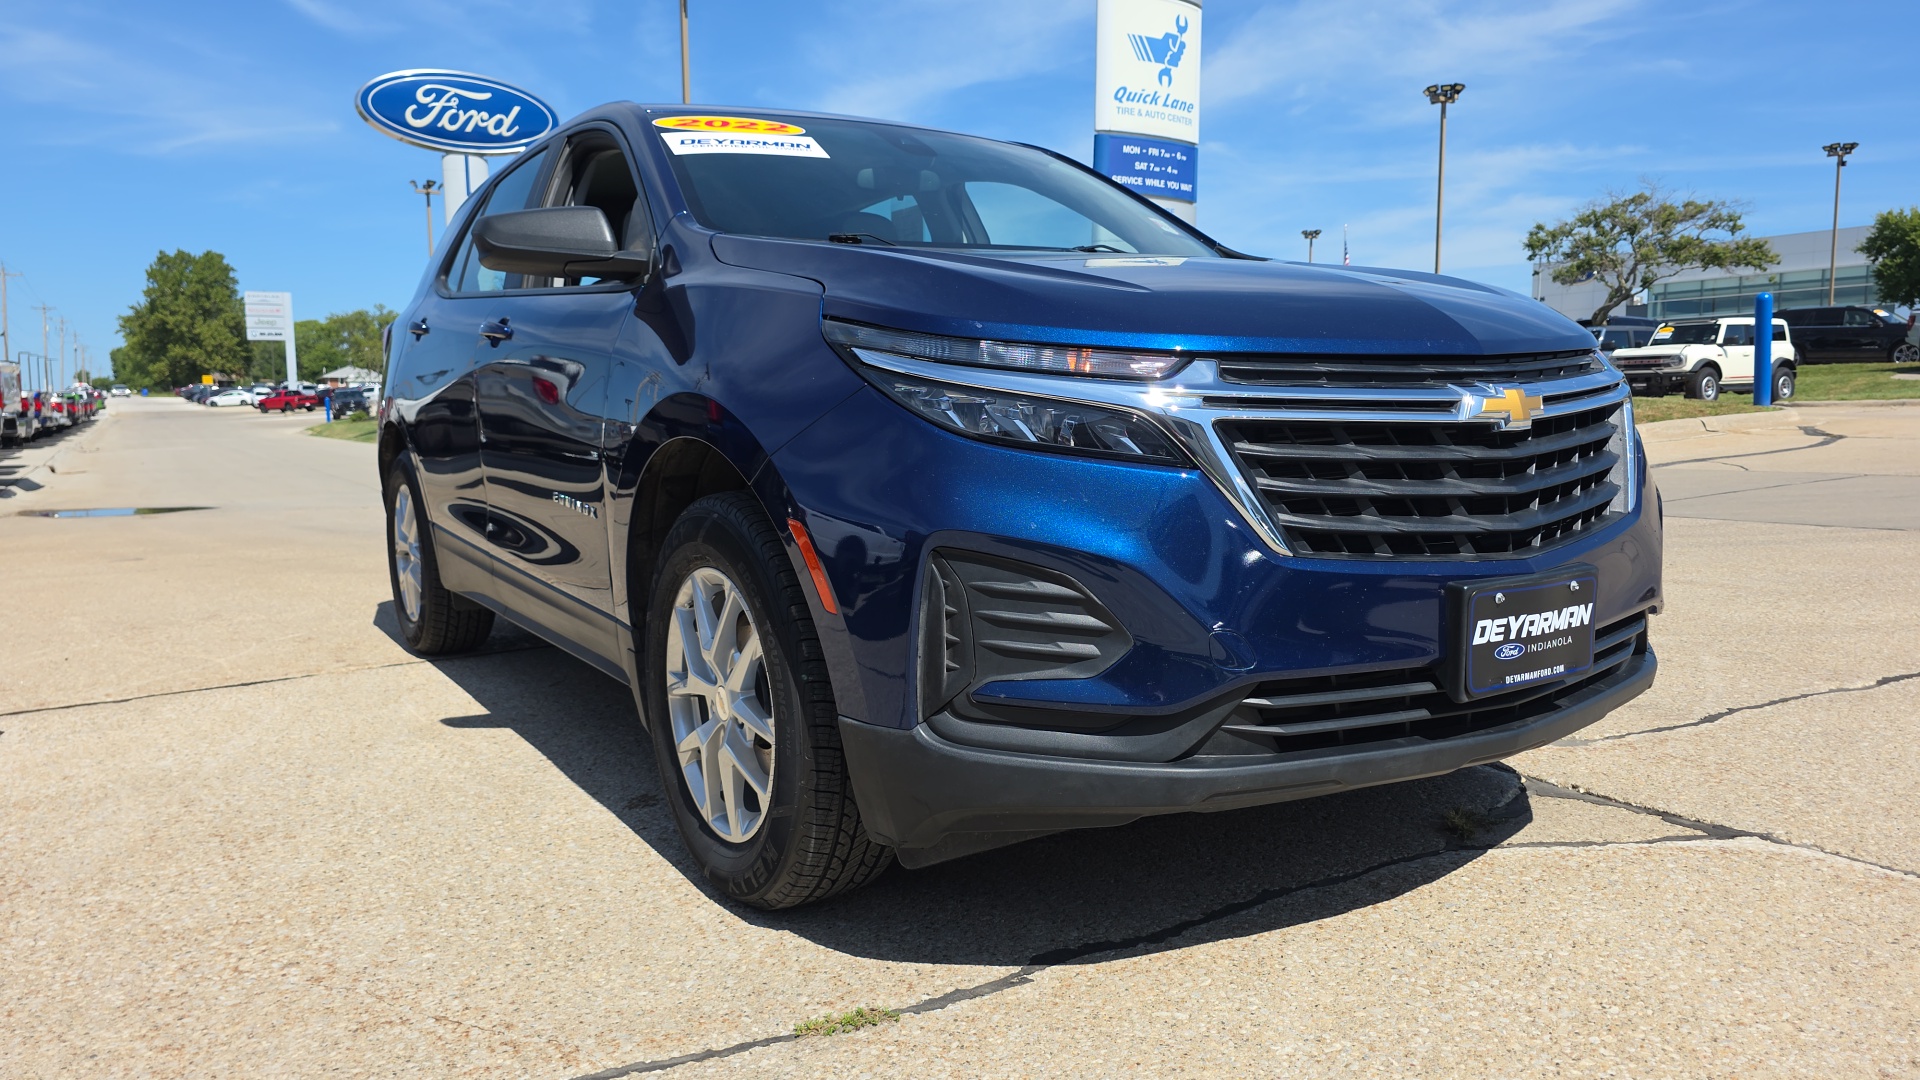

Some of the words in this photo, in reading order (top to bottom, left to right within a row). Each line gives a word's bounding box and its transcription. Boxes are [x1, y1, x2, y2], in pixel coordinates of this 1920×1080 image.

[1113, 86, 1161, 105] Quick
[1162, 93, 1194, 113] Lane
[405, 84, 521, 137] Ford
[1116, 106, 1135, 116] TIRE
[1137, 108, 1143, 117] &
[1145, 109, 1166, 120] AUTO
[1167, 113, 1193, 126] CENTER
[673, 118, 789, 133] 2022
[680, 138, 811, 149] DEYARMAN
[1122, 145, 1140, 155] MON
[1148, 147, 1159, 156] FRI
[1134, 161, 1148, 170] SAT
[1112, 175, 1143, 185] SERVICE
[1145, 177, 1165, 188] WHILE
[1167, 180, 1179, 190] YOU
[1180, 183, 1193, 192] WAIT
[1472, 602, 1594, 646] DEYARMAN
[1500, 645, 1520, 657] Ford
[1527, 635, 1573, 653] INDIANOLA
[1505, 664, 1565, 684] DEYARMANFORD.COM
[729, 838, 779, 894] KELLY
